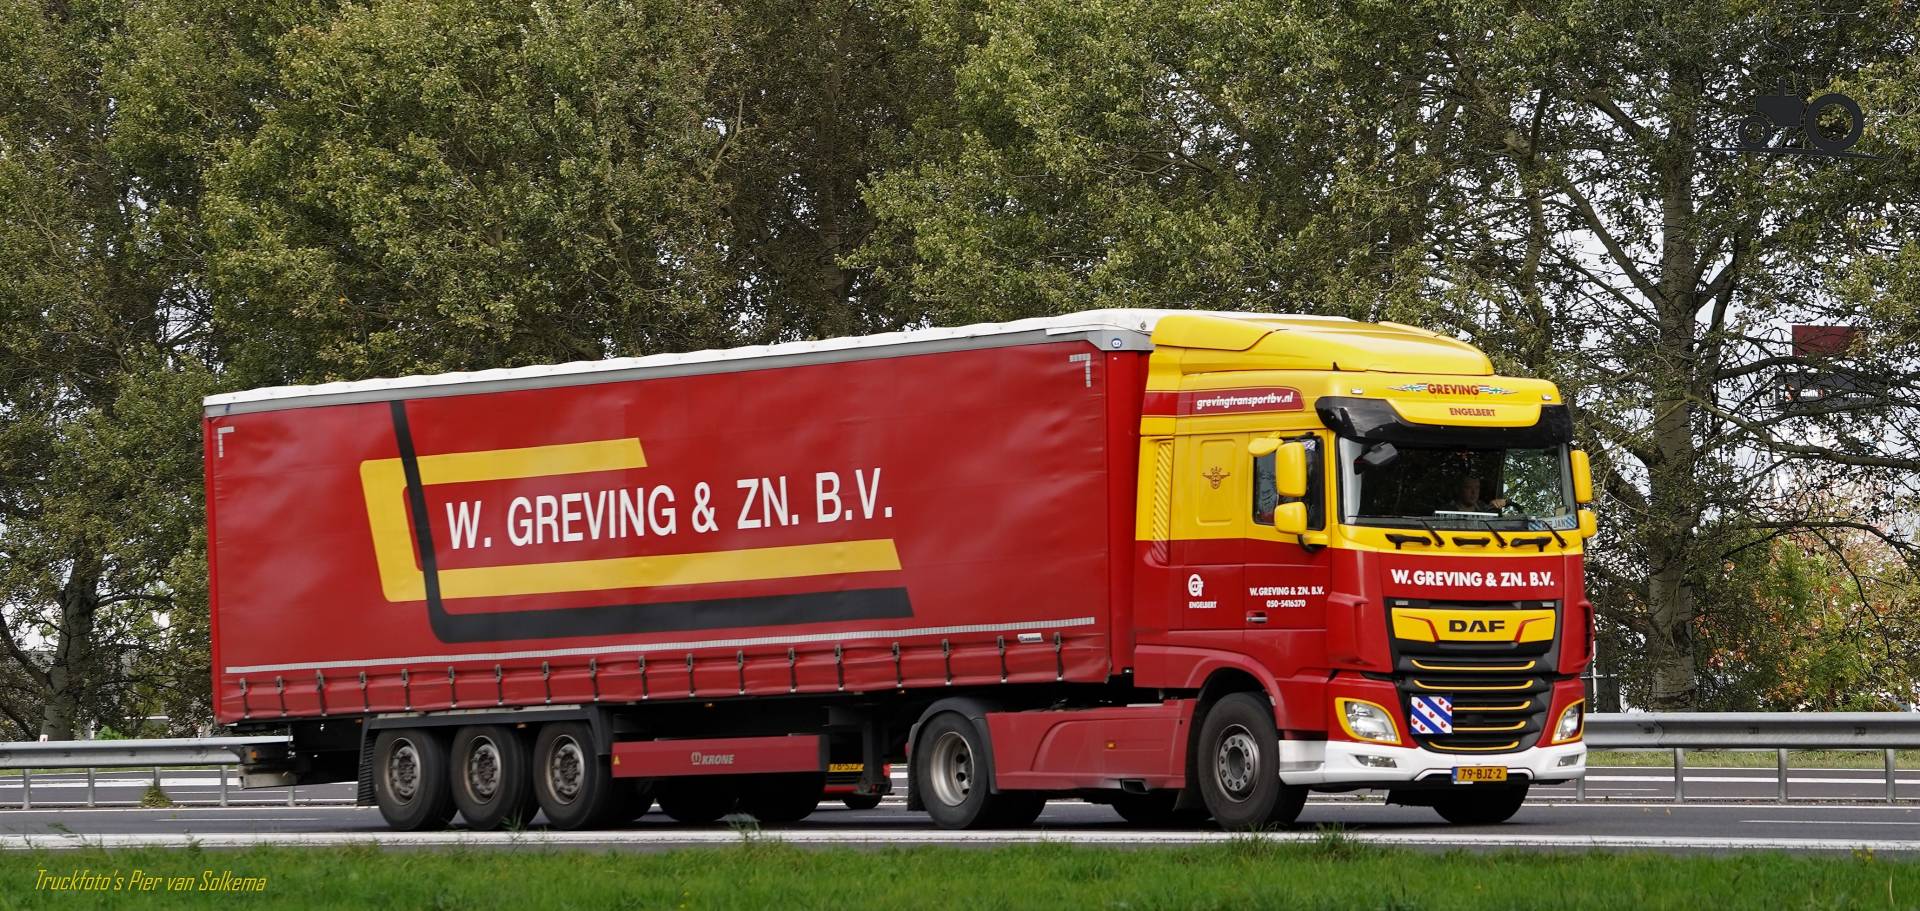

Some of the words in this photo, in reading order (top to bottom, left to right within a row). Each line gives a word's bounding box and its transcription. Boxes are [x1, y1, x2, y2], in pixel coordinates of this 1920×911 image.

[1428, 384, 1480, 395] GREVING
[1197, 390, 1293, 411] grevingtransportbv.nl
[1450, 408, 1495, 416] ENGELBERT
[446, 501, 491, 549] W.
[508, 485, 676, 546] GREVING
[692, 482, 718, 533] &
[737, 476, 799, 529] ZN.
[816, 468, 892, 523] B.V.
[1391, 569, 1411, 584] W.
[1414, 570, 1482, 586] GREVING
[1485, 572, 1497, 586] &
[1501, 572, 1526, 586] ZN.
[1530, 572, 1554, 586] B.V.
[1250, 588, 1259, 596] W.
[1258, 587, 1289, 596] GREVING
[1290, 587, 1296, 595] &
[1297, 587, 1310, 595] ZN.
[1311, 586, 1324, 595] B.V.
[1449, 620, 1504, 632] DAF
[701, 754, 735, 765] KRONE
[1460, 768, 1503, 779] 79-BJZ-2
